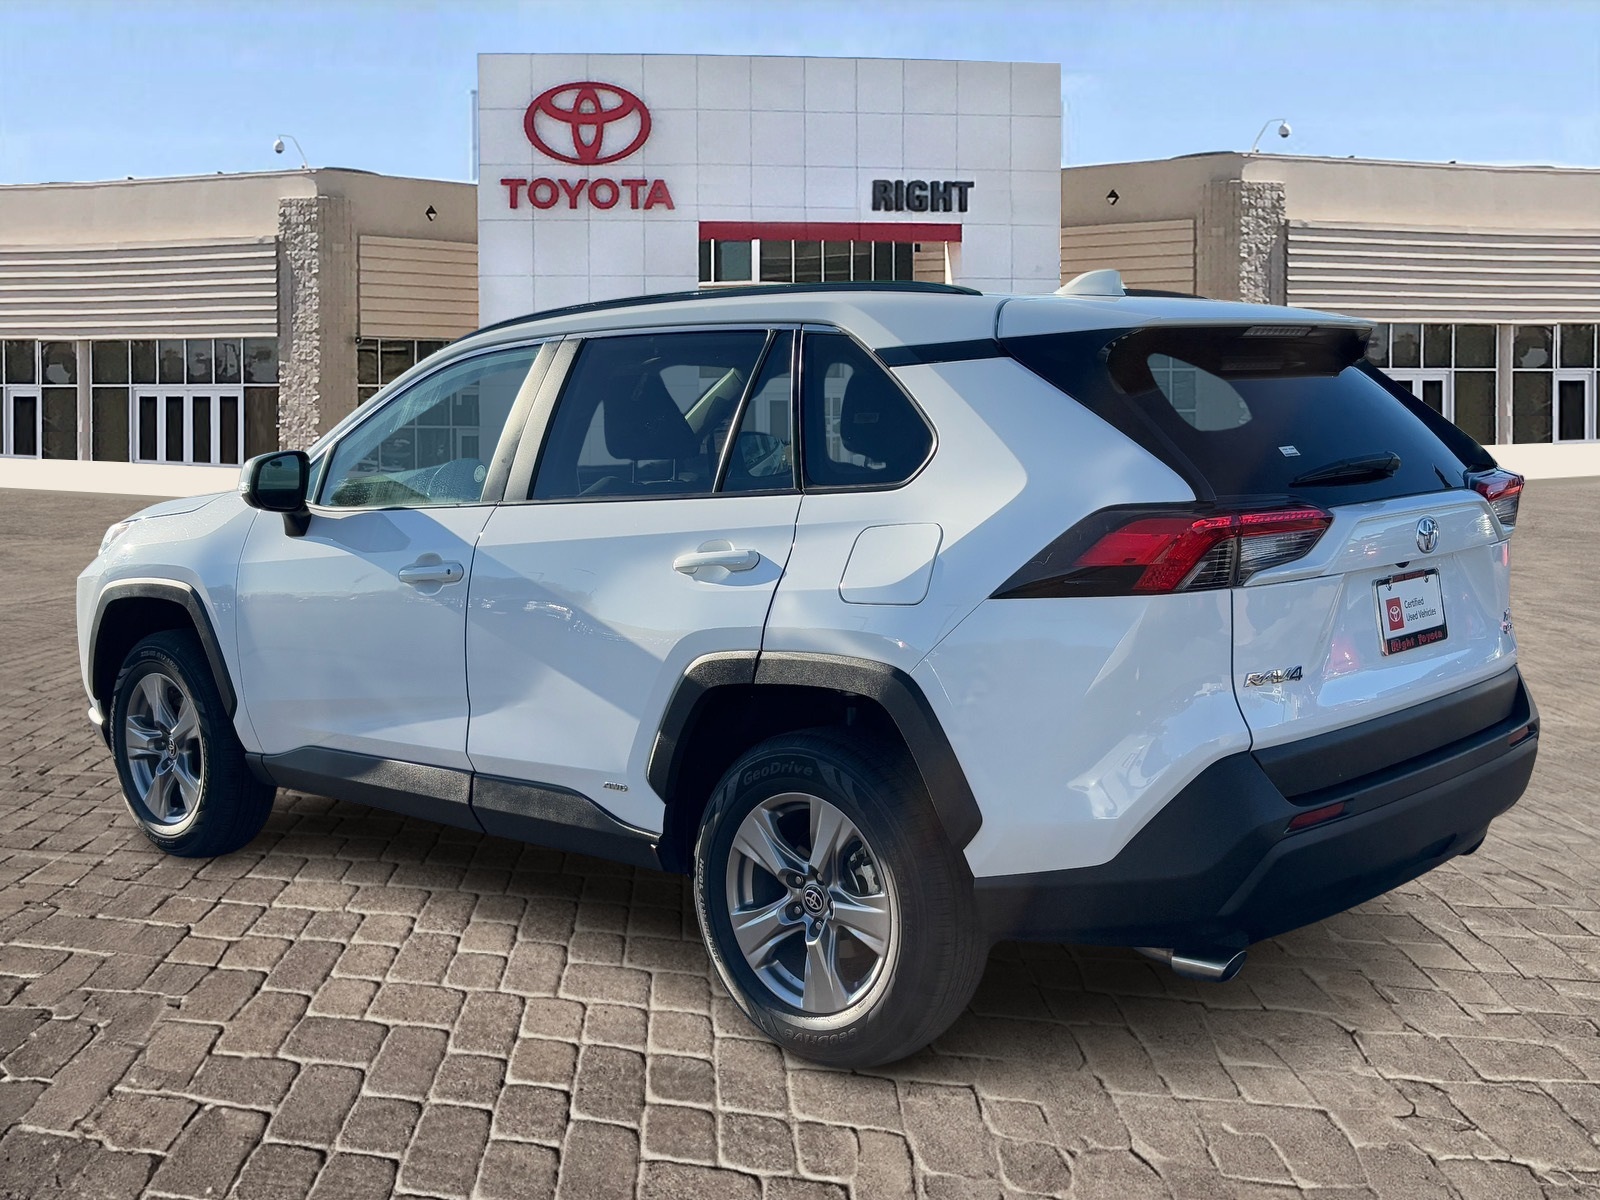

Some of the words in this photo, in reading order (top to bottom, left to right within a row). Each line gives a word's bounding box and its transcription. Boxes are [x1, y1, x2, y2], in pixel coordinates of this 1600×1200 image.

[500, 177, 675, 210] TOYOTA
[872, 179, 975, 212] RIGHT
[1404, 597, 1424, 609] Certified
[1406, 611, 1418, 622] Used
[1418, 608, 1437, 619] Vehicles
[1391, 636, 1415, 652] Right
[1417, 630, 1443, 645] Toyota
[1243, 665, 1303, 688] RAV4
[743, 760, 813, 786] GeoDrive
